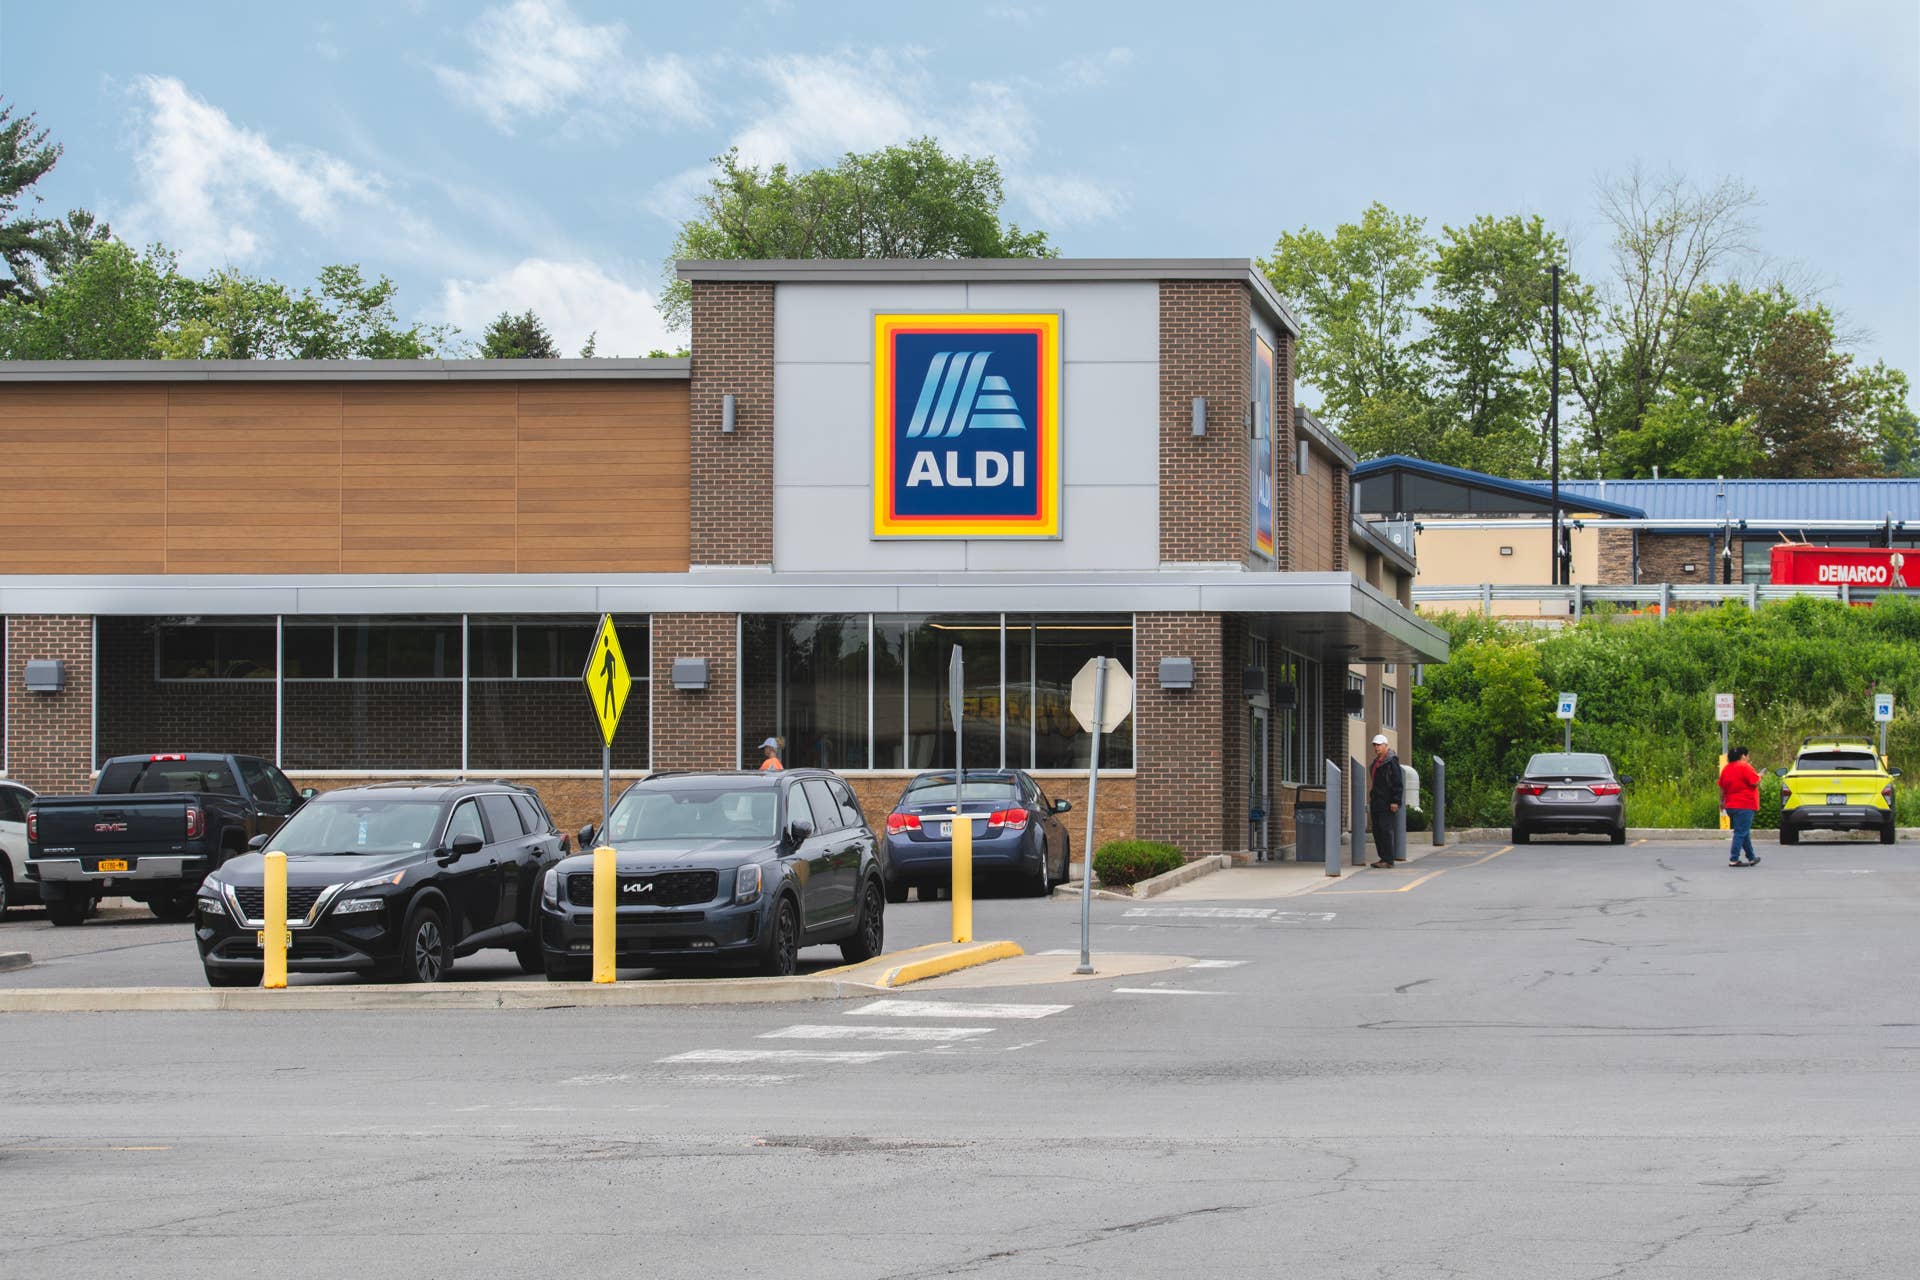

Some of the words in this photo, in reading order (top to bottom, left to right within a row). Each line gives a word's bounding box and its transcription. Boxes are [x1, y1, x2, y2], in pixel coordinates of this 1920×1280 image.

[906, 451, 1025, 487] ALDI
[1819, 565, 1887, 583] DEMARCO
[94, 823, 128, 832] GMC
[623, 883, 653, 893] KIA
